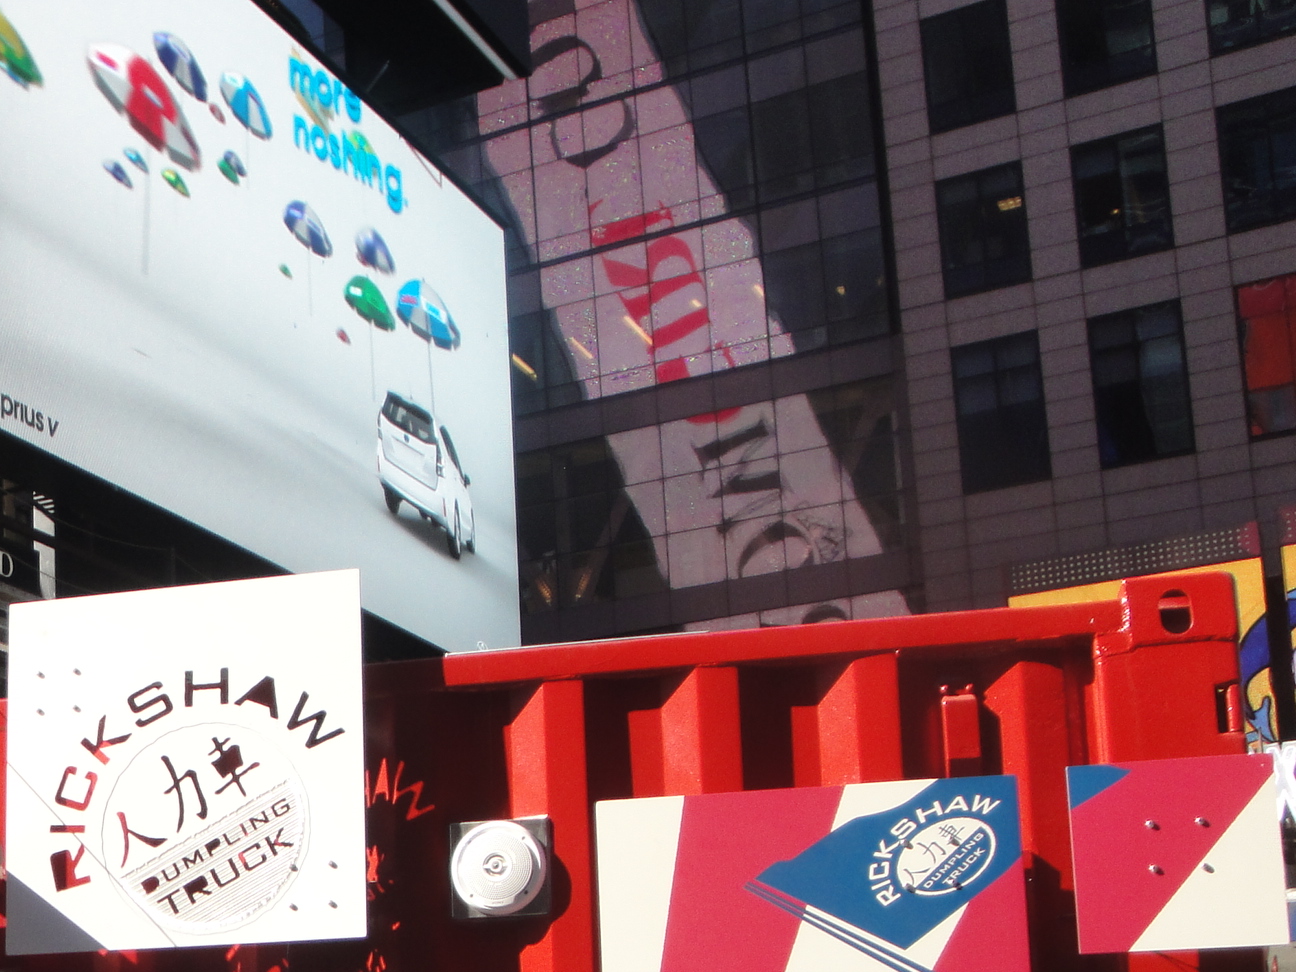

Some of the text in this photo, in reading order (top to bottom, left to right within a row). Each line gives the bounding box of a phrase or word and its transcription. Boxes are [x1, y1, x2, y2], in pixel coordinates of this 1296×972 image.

[1, 393, 59, 438] prius v
[50, 667, 346, 892] RICKSHAW
[141, 798, 291, 894] DUMPLING
[157, 828, 294, 914] TRUCK
[868, 795, 1001, 906] RICKSHAW
[923, 833, 985, 889] DUMPLING
[942, 847, 986, 886] TRUCK
